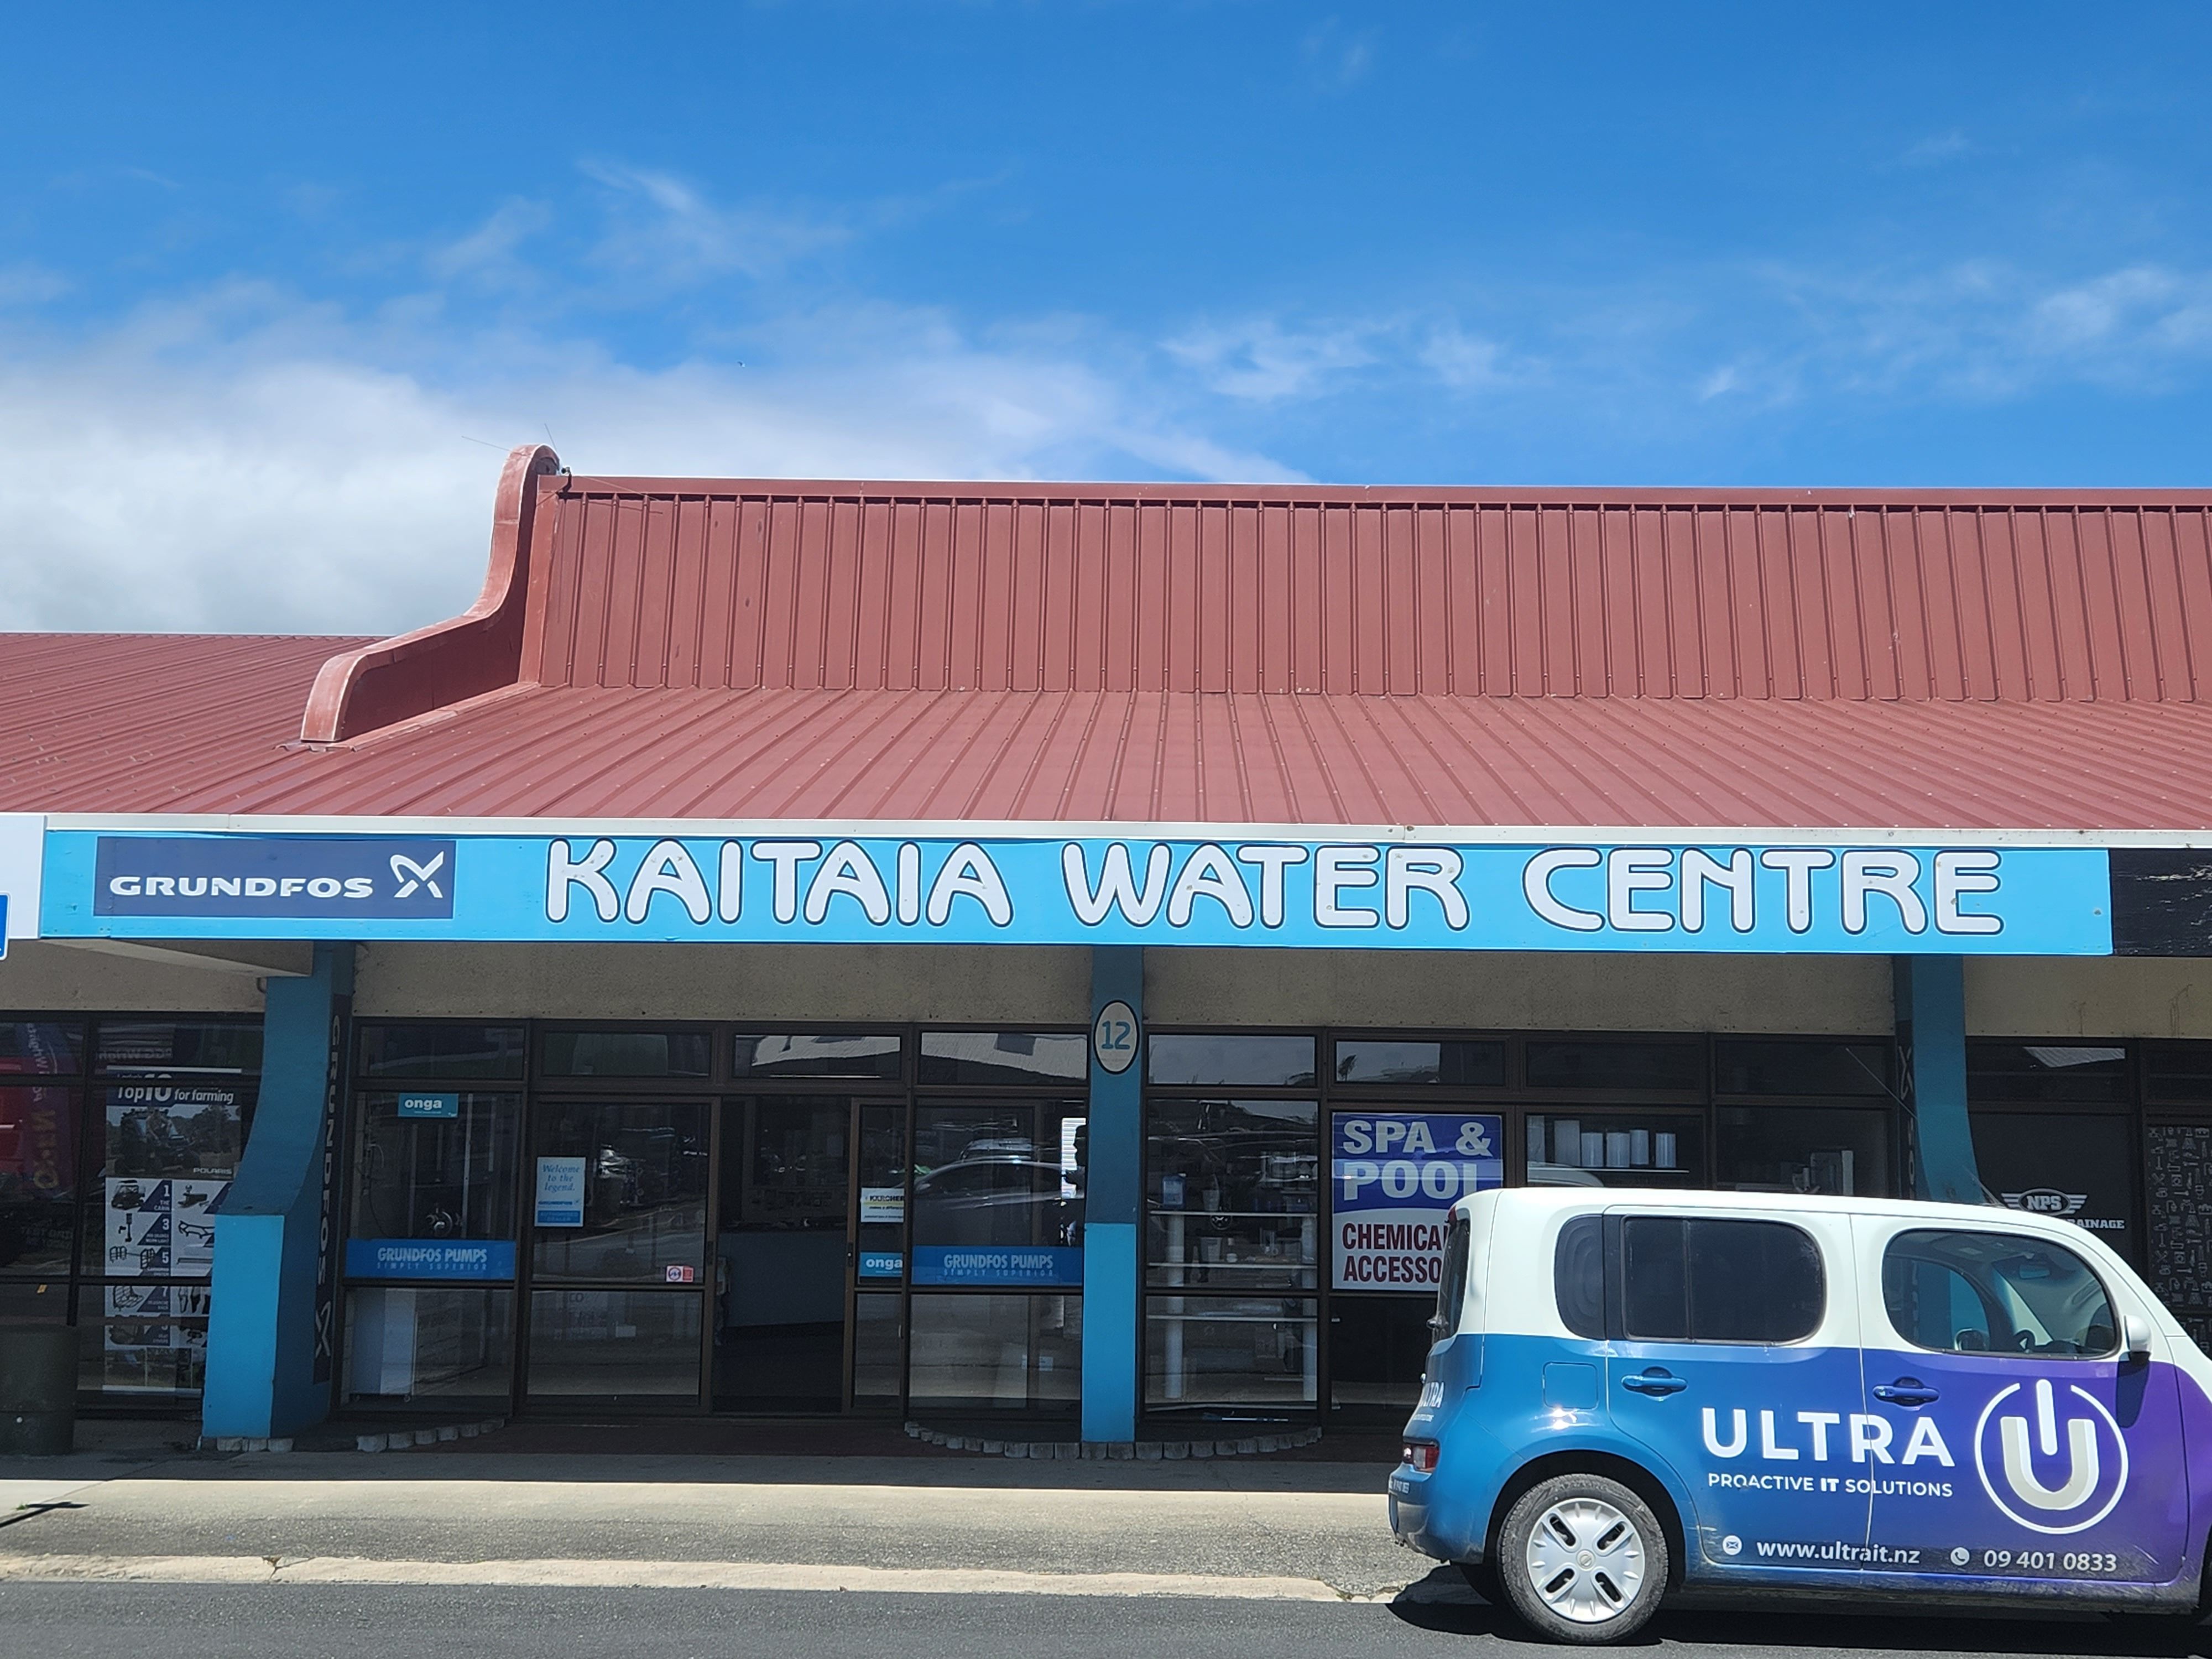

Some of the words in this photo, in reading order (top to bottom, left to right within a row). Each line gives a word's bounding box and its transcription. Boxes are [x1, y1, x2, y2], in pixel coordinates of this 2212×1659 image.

[110, 876, 373, 898] GRUNDFOS
[546, 837, 1014, 927] KAITAIA
[1061, 842, 1470, 931] WATER
[1521, 847, 2004, 935] CENTRE
[1102, 1021, 1131, 1050] 12
[174, 1090, 188, 1101] for
[191, 1089, 234, 1104] farming
[404, 1099, 442, 1111] onga
[1343, 1119, 1437, 1155] SPA
[1455, 1121, 1493, 1157] &
[542, 1164, 580, 1173] Welcome
[164, 1185, 170, 1197] 1
[544, 1182, 576, 1193] legend.
[2026, 1196, 2063, 1211] NPS
[162, 1218, 169, 1230] 3
[1343, 1223, 1448, 1251] CHEMICA
[161, 1253, 169, 1264] 5
[377, 1247, 442, 1262] GRUNDFOS
[445, 1248, 488, 1263] PUMPS
[943, 1254, 1008, 1269] GRUNDFOS
[1011, 1254, 1053, 1270] PUMPS
[865, 1258, 903, 1270] onga
[1702, 1407, 1955, 1467] ULTRA
[1708, 1473, 1814, 1491] PROACTIVE
[1820, 1477, 1840, 1492] IT
[1845, 1479, 1953, 1498] SOLUTIONS
[1756, 1540, 1920, 1564] www.ultrait.nz
[1983, 1550, 2010, 1568] 09
[2016, 1551, 2055, 1569] 401
[2063, 1552, 2117, 1572] 0833
